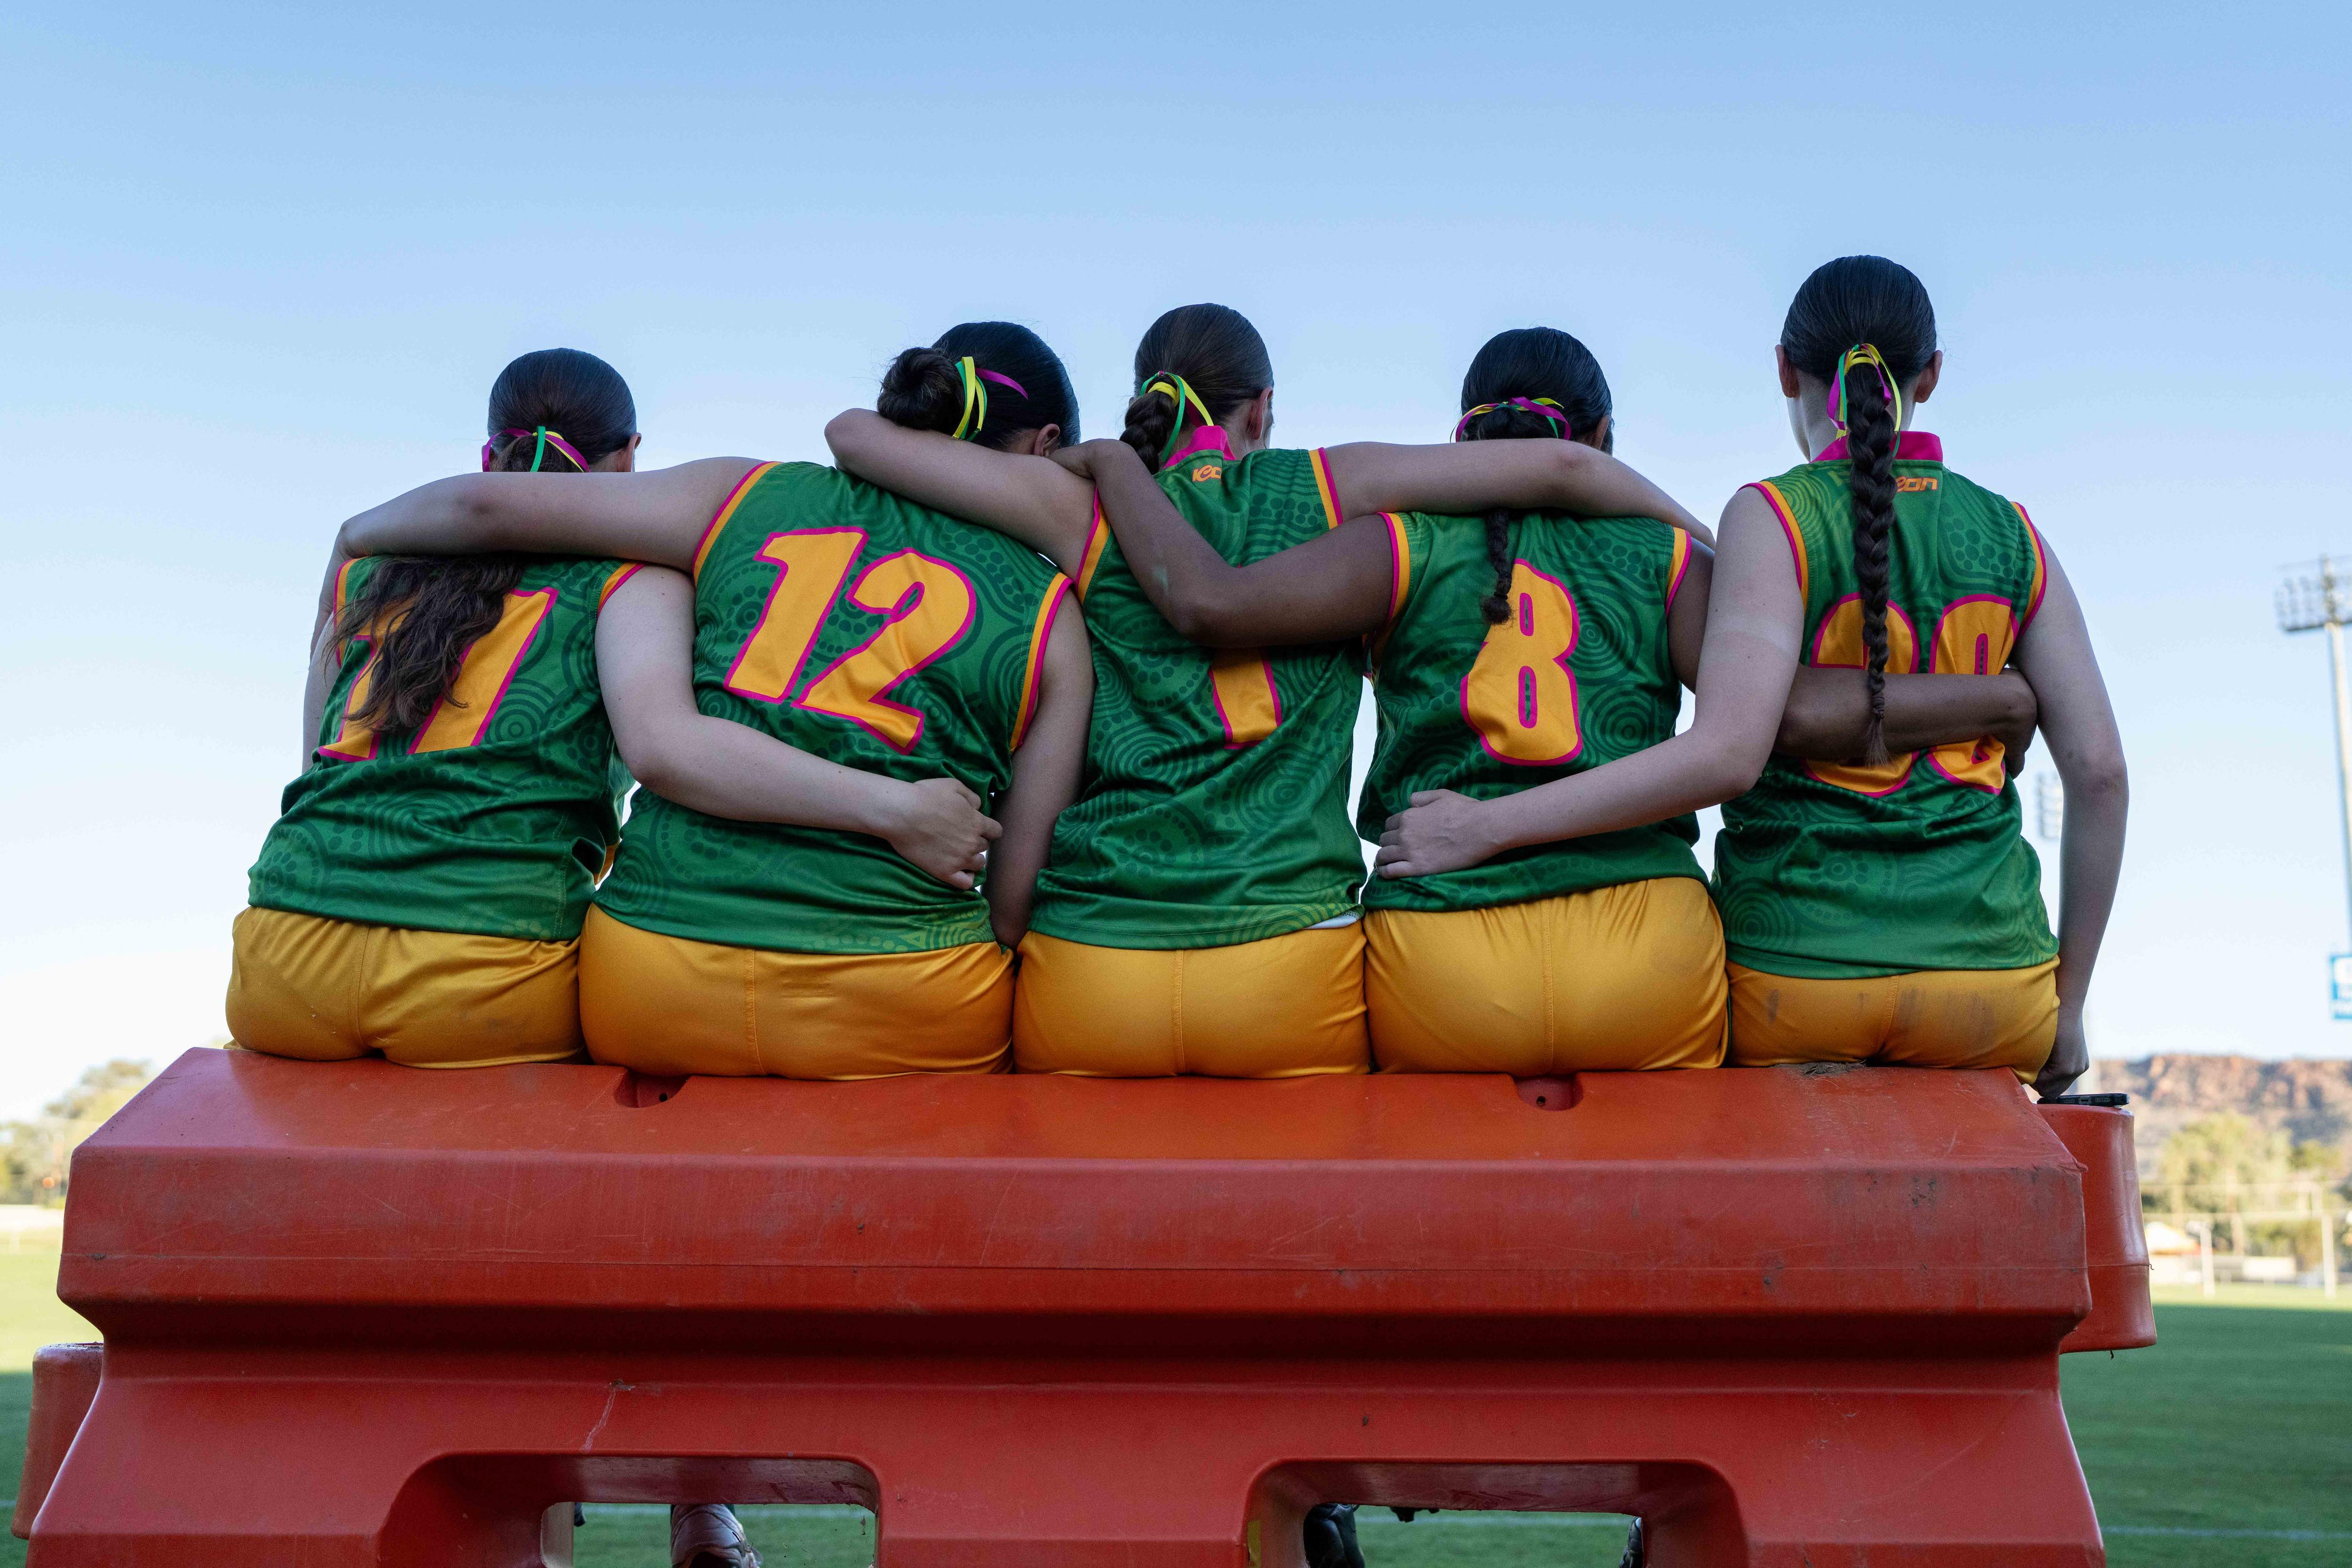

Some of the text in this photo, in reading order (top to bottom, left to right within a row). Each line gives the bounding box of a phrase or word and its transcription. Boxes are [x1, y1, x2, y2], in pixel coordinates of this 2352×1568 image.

[1896, 475, 1938, 493] eon
[723, 526, 977, 756] 12
[1460, 558, 1583, 766] 8
